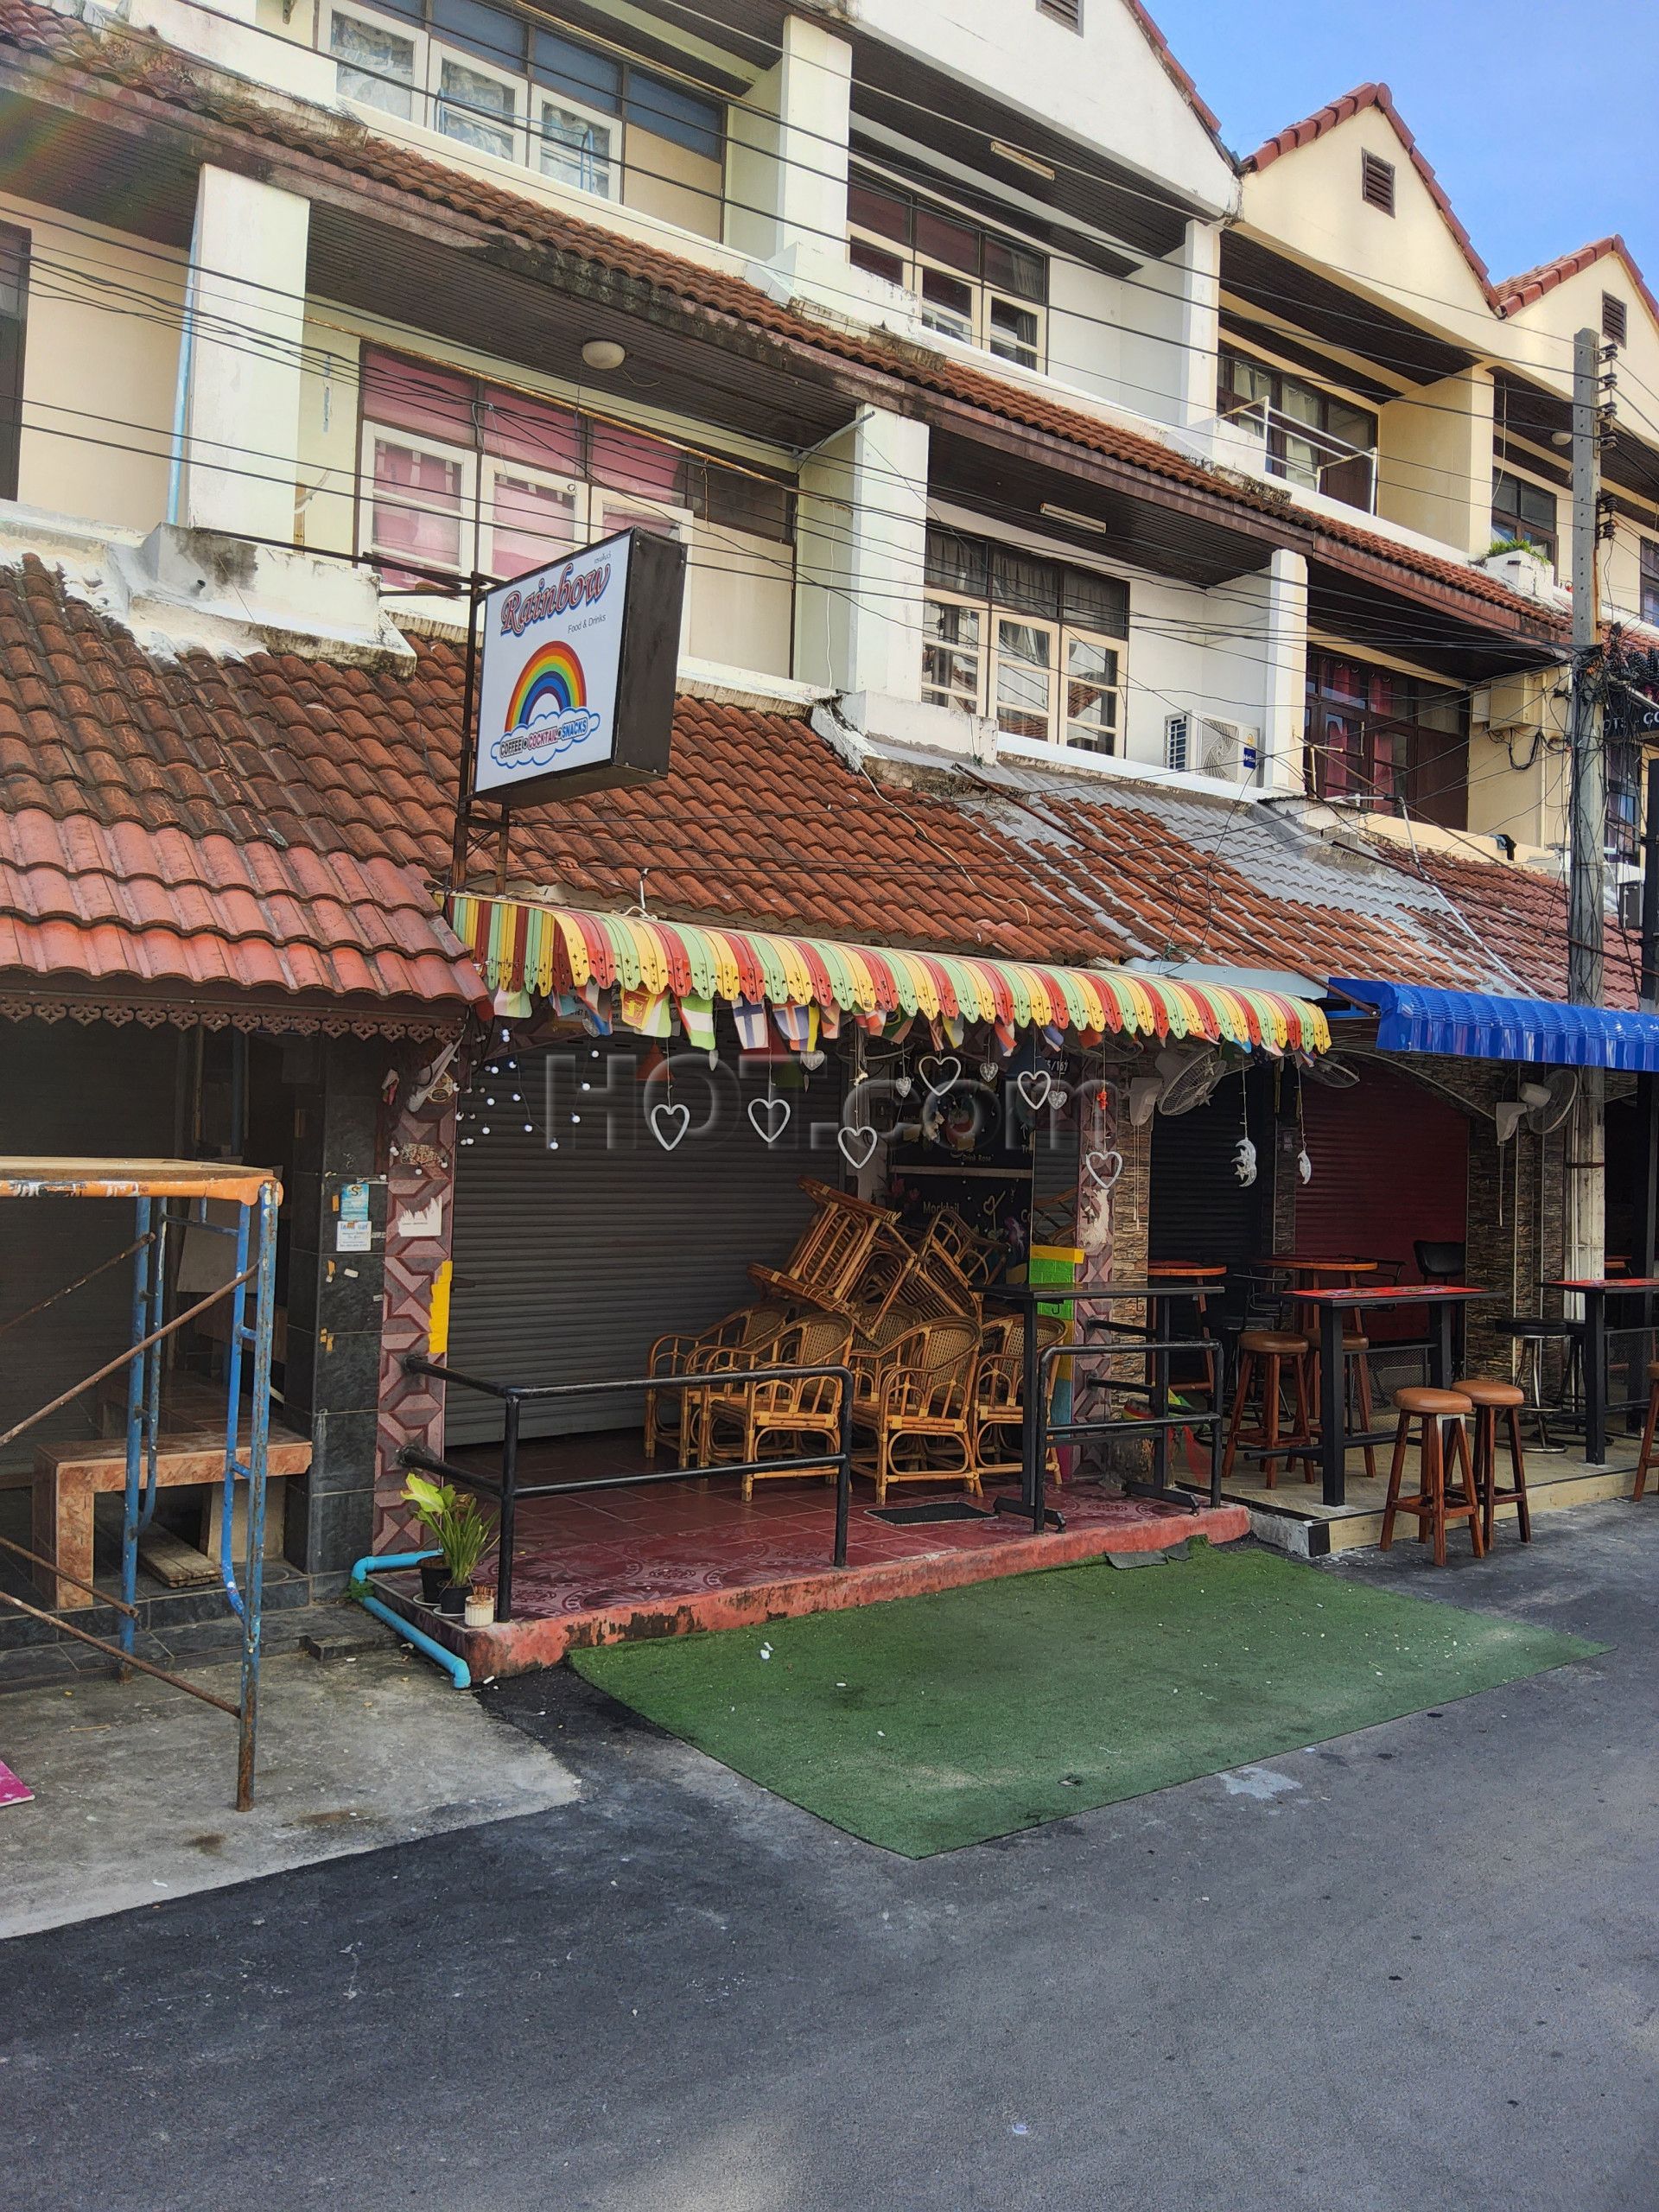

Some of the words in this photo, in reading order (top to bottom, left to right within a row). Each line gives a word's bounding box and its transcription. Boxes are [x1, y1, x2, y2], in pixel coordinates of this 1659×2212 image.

[500, 563, 611, 638] Rainbow
[568, 621, 582, 633] Food
[582, 619, 588, 628] &
[588, 613, 607, 626] Drinks
[500, 738, 523, 757] COFFEE
[528, 728, 558, 749] COCKTAIL
[562, 719, 588, 740] SNACKS
